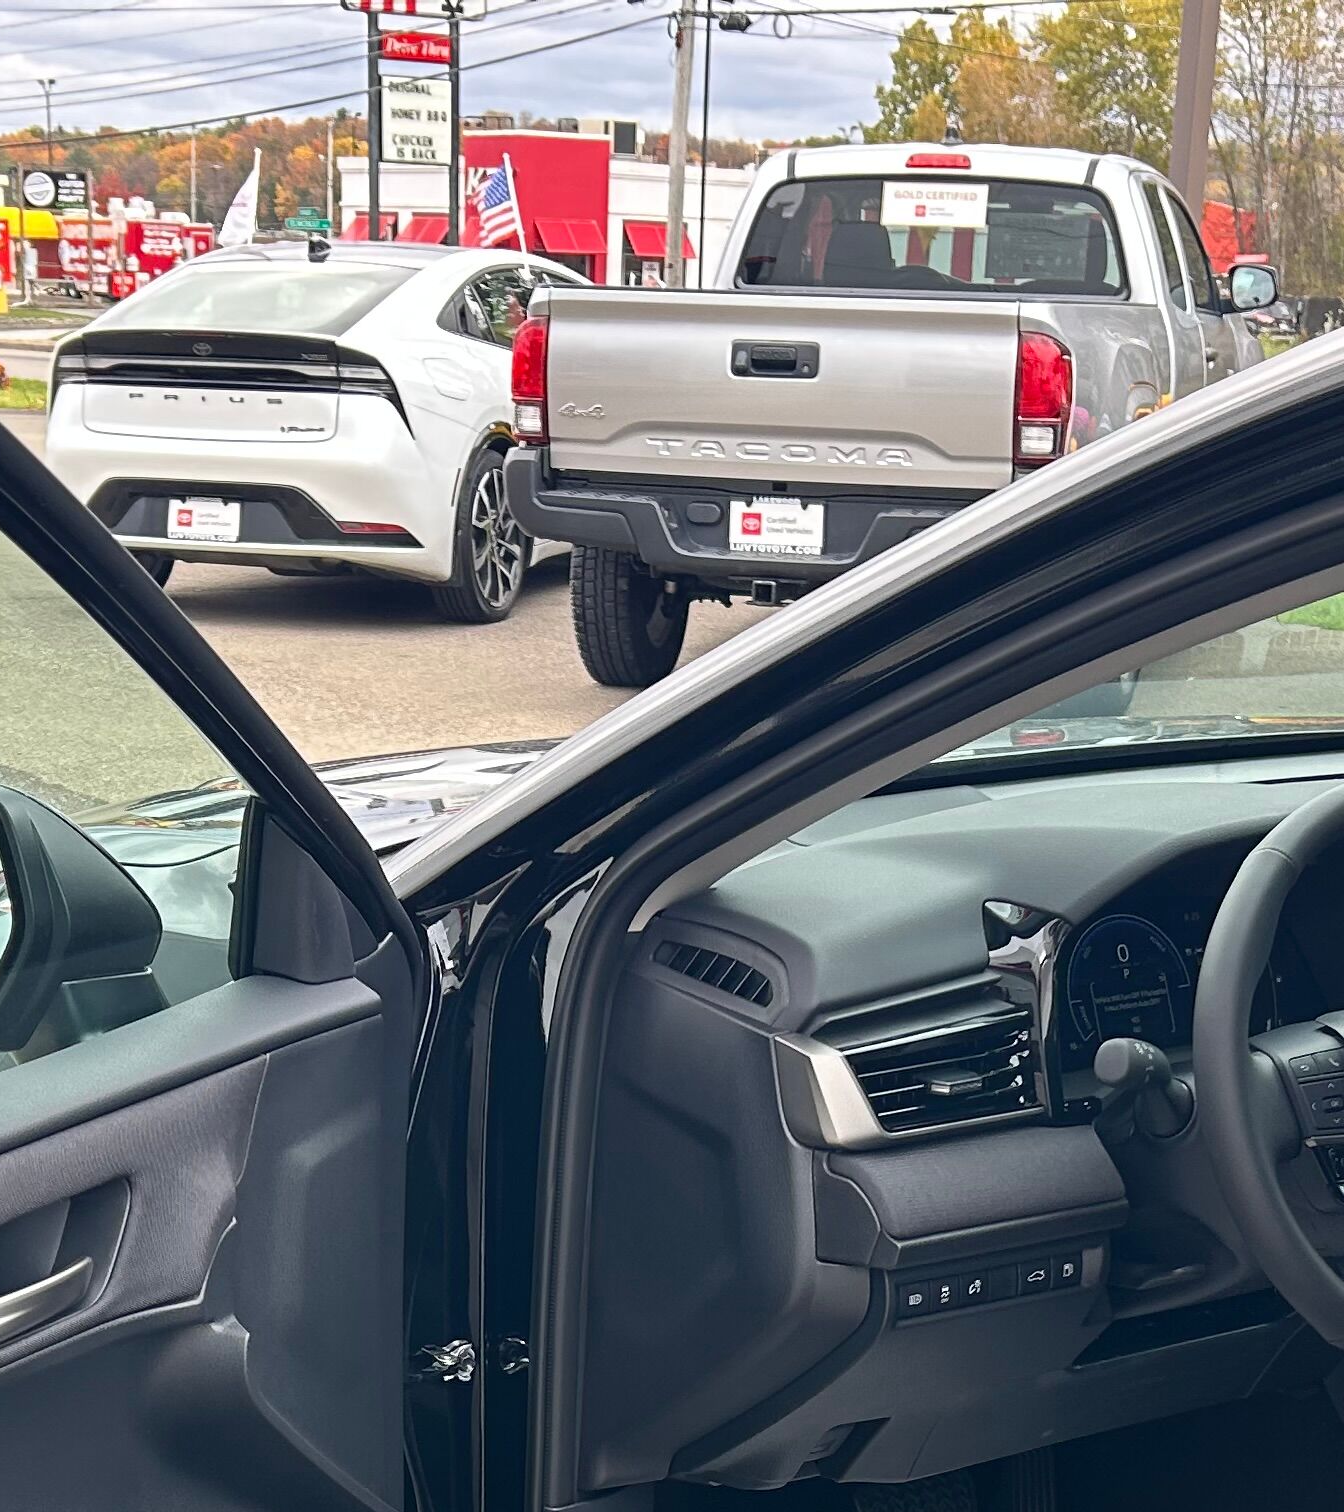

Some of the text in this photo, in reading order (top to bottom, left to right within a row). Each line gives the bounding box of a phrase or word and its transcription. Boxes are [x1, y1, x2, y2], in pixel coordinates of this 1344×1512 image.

[386, 37, 418, 55] Drive
[390, 107, 421, 121] HONEY
[392, 134, 434, 147] CHICKEN
[412, 149, 437, 160] BACK
[894, 190, 978, 202] GOLD CERTIFIED
[129, 392, 283, 405] PRIUS
[645, 437, 913, 467] TACOMA
[730, 543, 822, 555] LUVTOYOTA.COM
